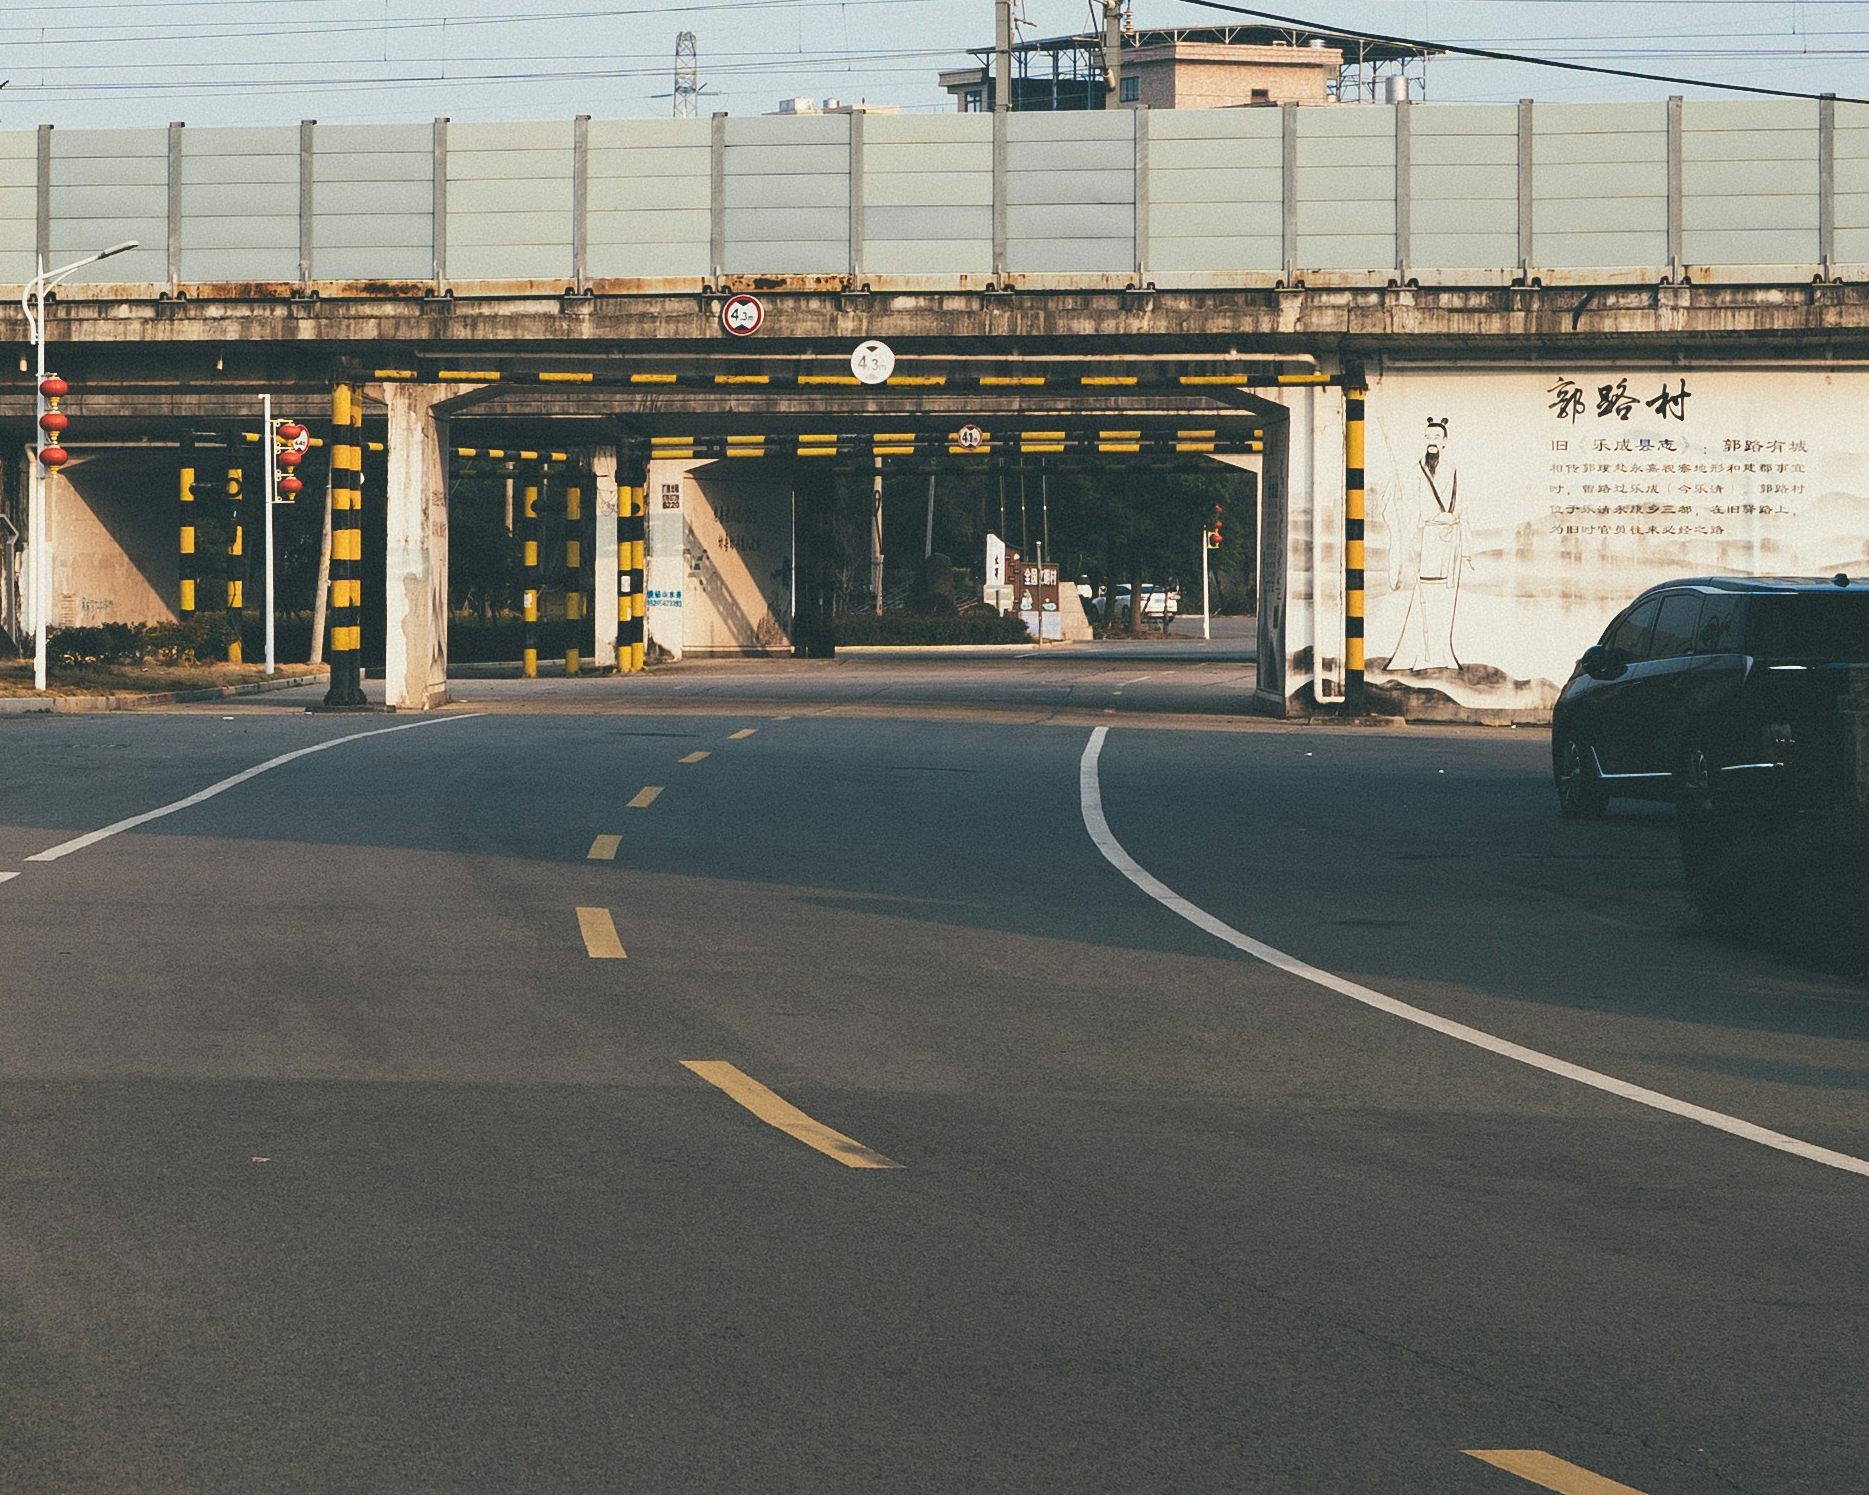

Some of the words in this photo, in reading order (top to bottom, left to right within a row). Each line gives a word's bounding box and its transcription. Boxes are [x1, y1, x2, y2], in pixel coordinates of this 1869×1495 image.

[730, 308, 754, 321] 4.3m
[857, 355, 887, 371] 4.3m
[1547, 377, 1692, 424] 郭路村
